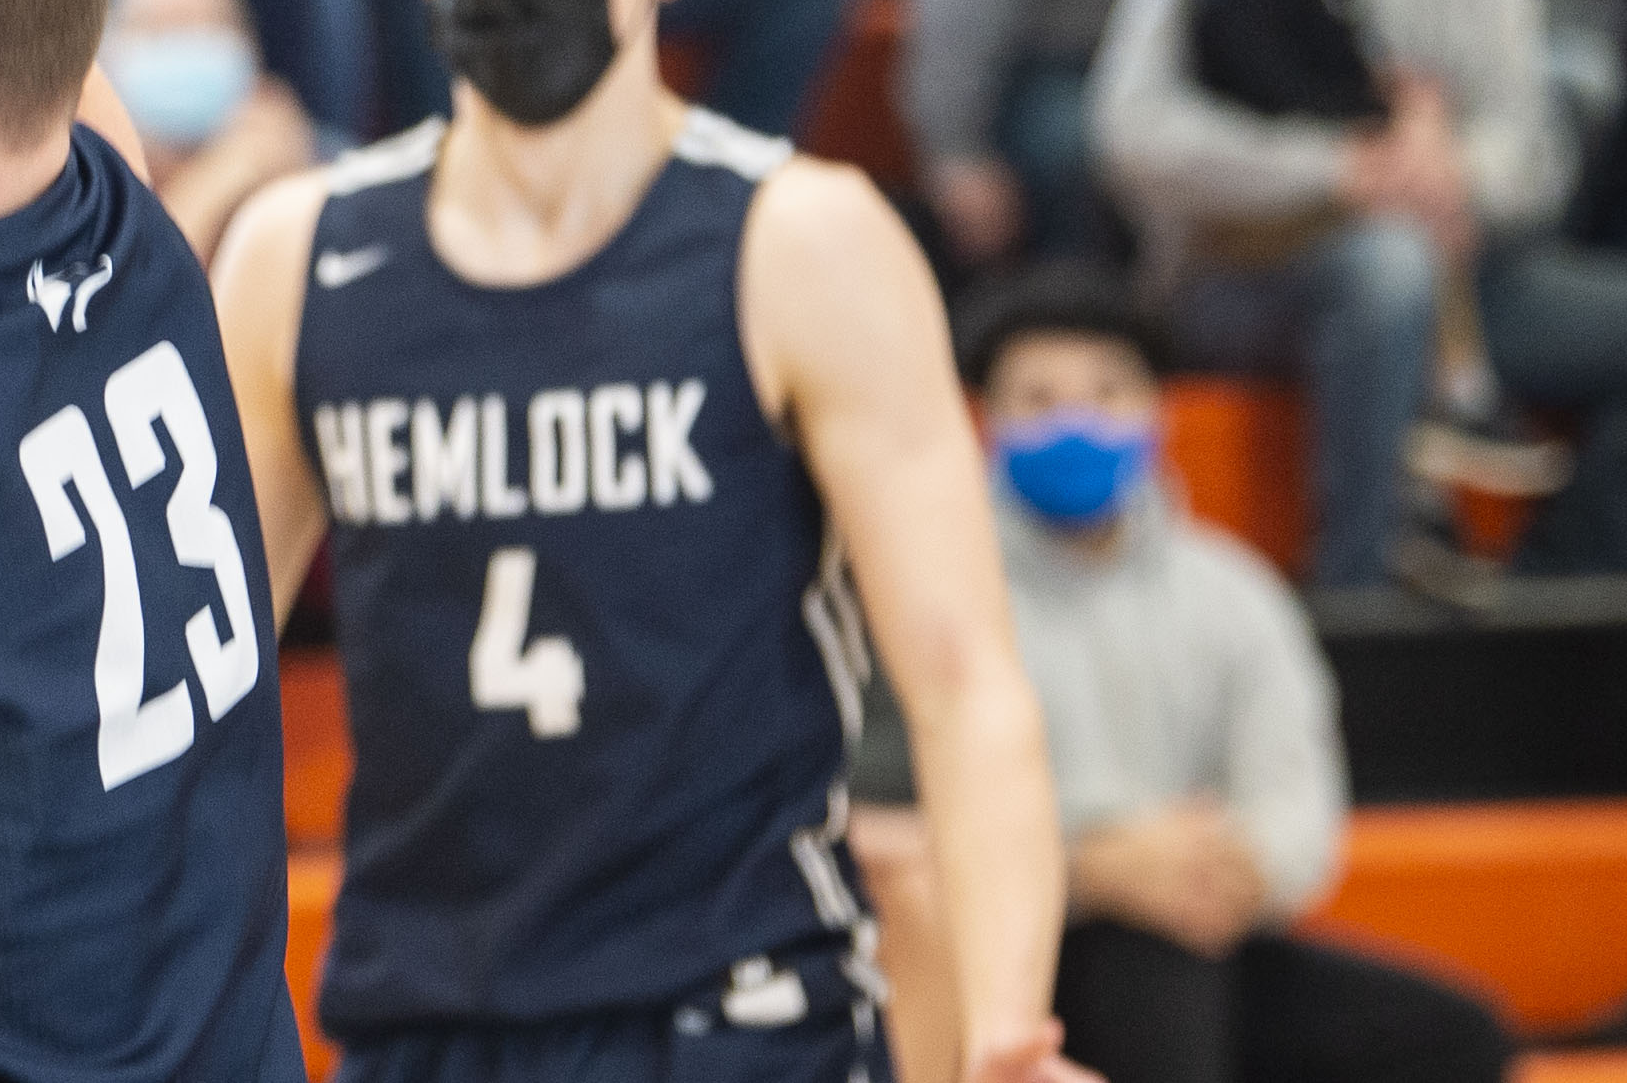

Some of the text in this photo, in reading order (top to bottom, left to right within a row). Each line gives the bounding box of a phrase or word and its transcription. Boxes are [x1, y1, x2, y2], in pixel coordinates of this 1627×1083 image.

[314, 378, 715, 527] HEMLOCK
[17, 339, 260, 793] 23
[468, 545, 586, 740] 4
